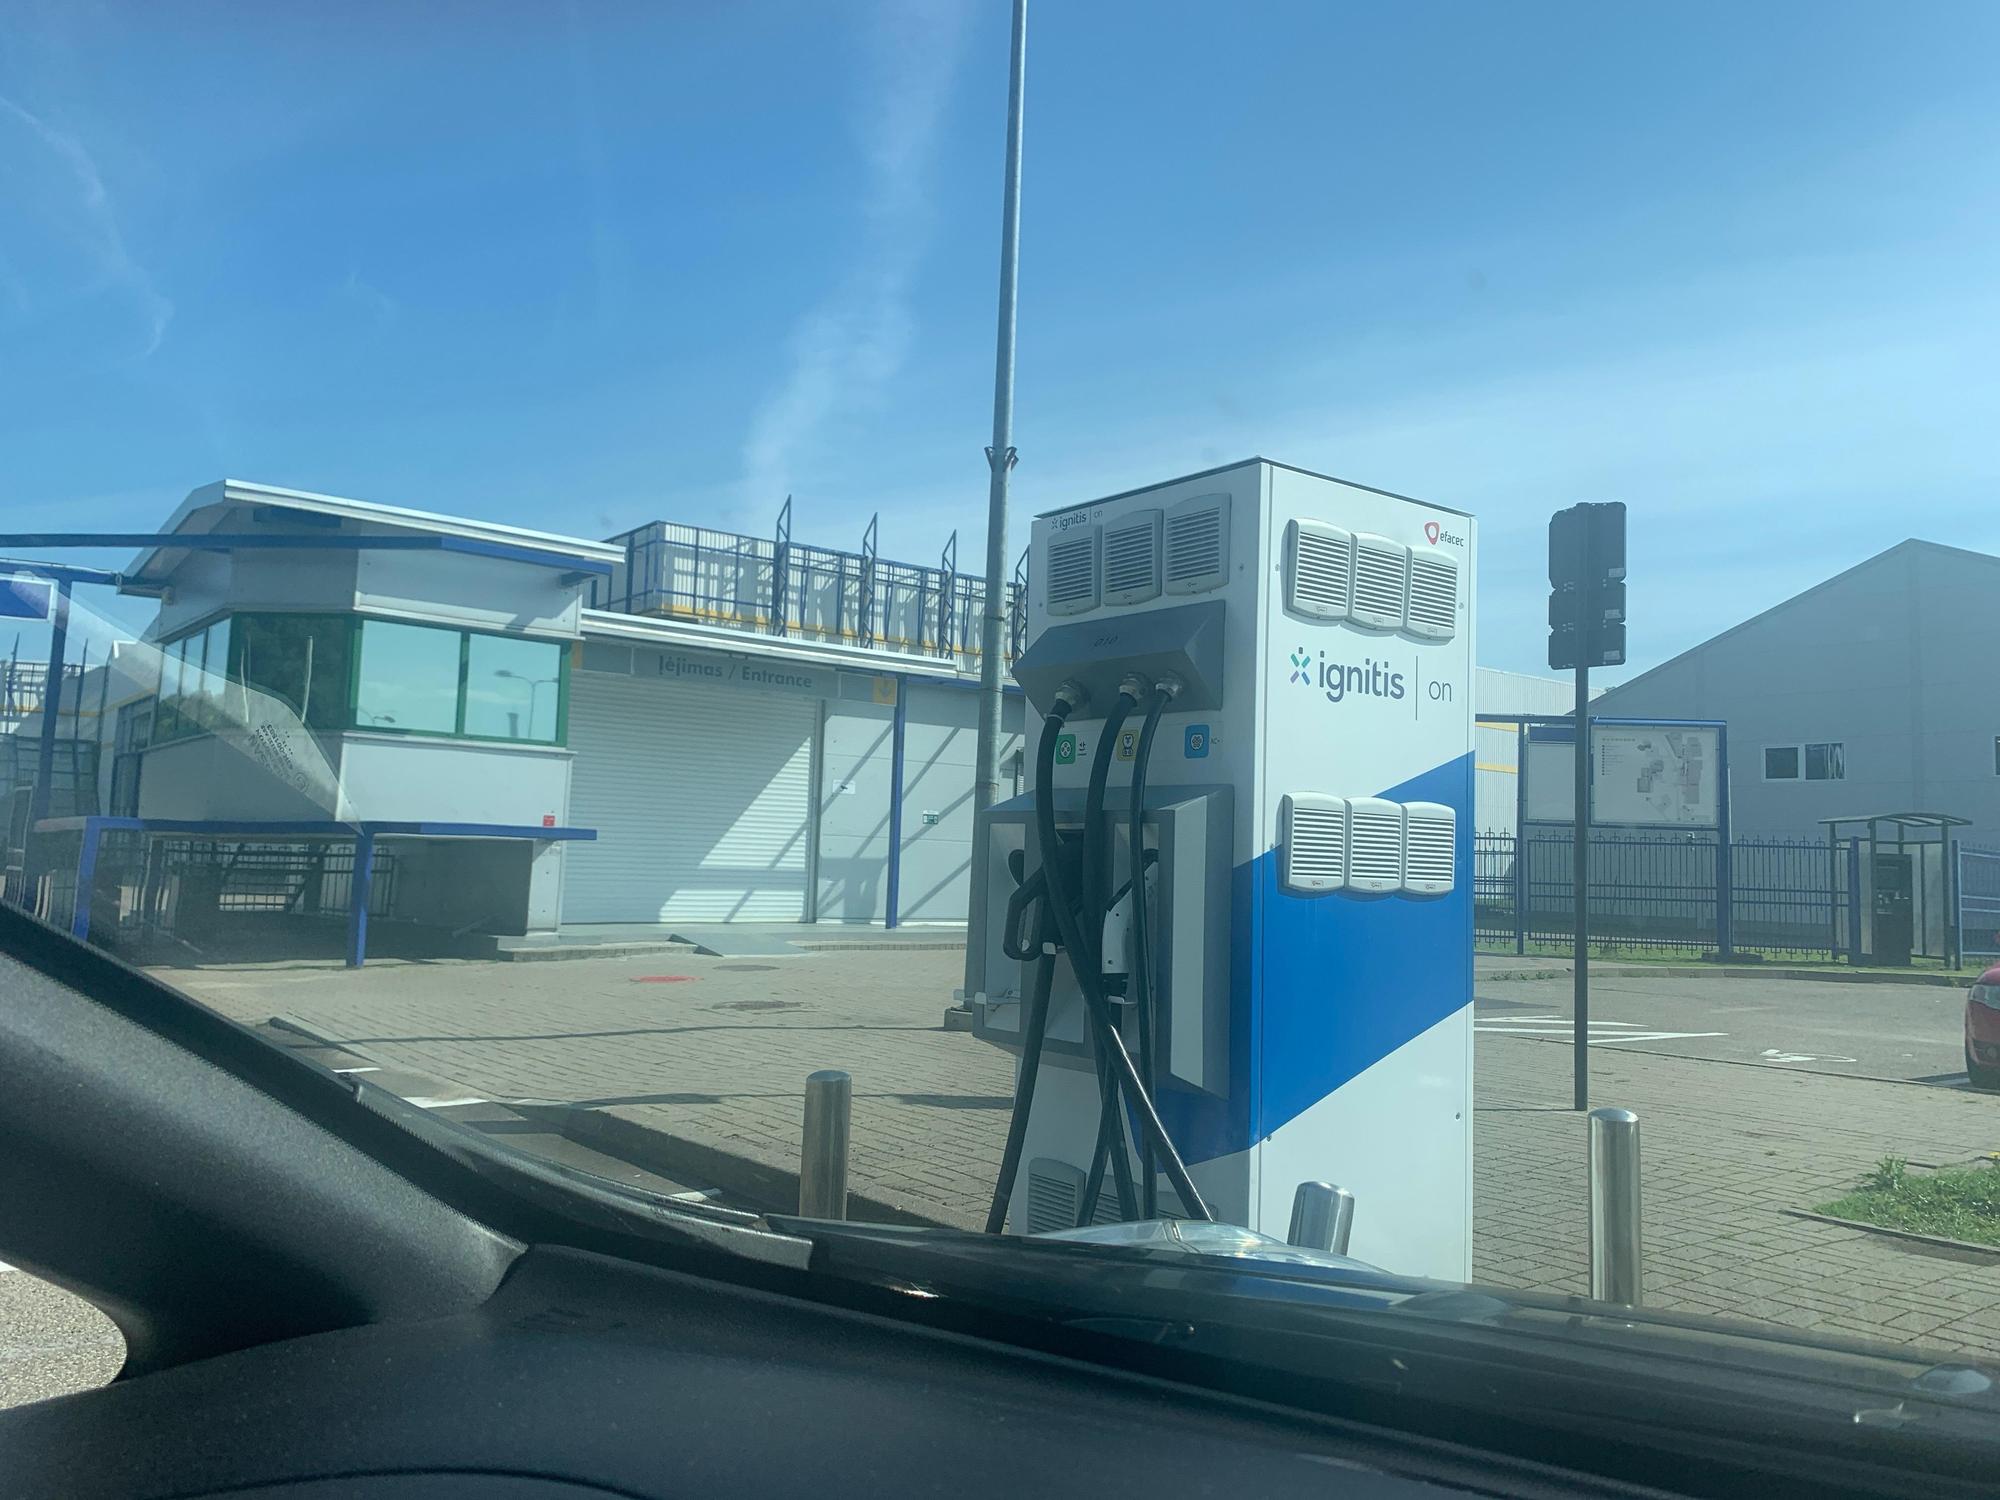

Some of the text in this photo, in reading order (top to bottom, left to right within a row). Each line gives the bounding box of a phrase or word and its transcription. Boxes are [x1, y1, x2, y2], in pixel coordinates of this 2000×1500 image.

[1059, 511, 1087, 531] ignitis
[1440, 531, 1464, 547] efacec
[742, 666, 812, 688] Entrance
[1319, 650, 1452, 703] ignitis on
